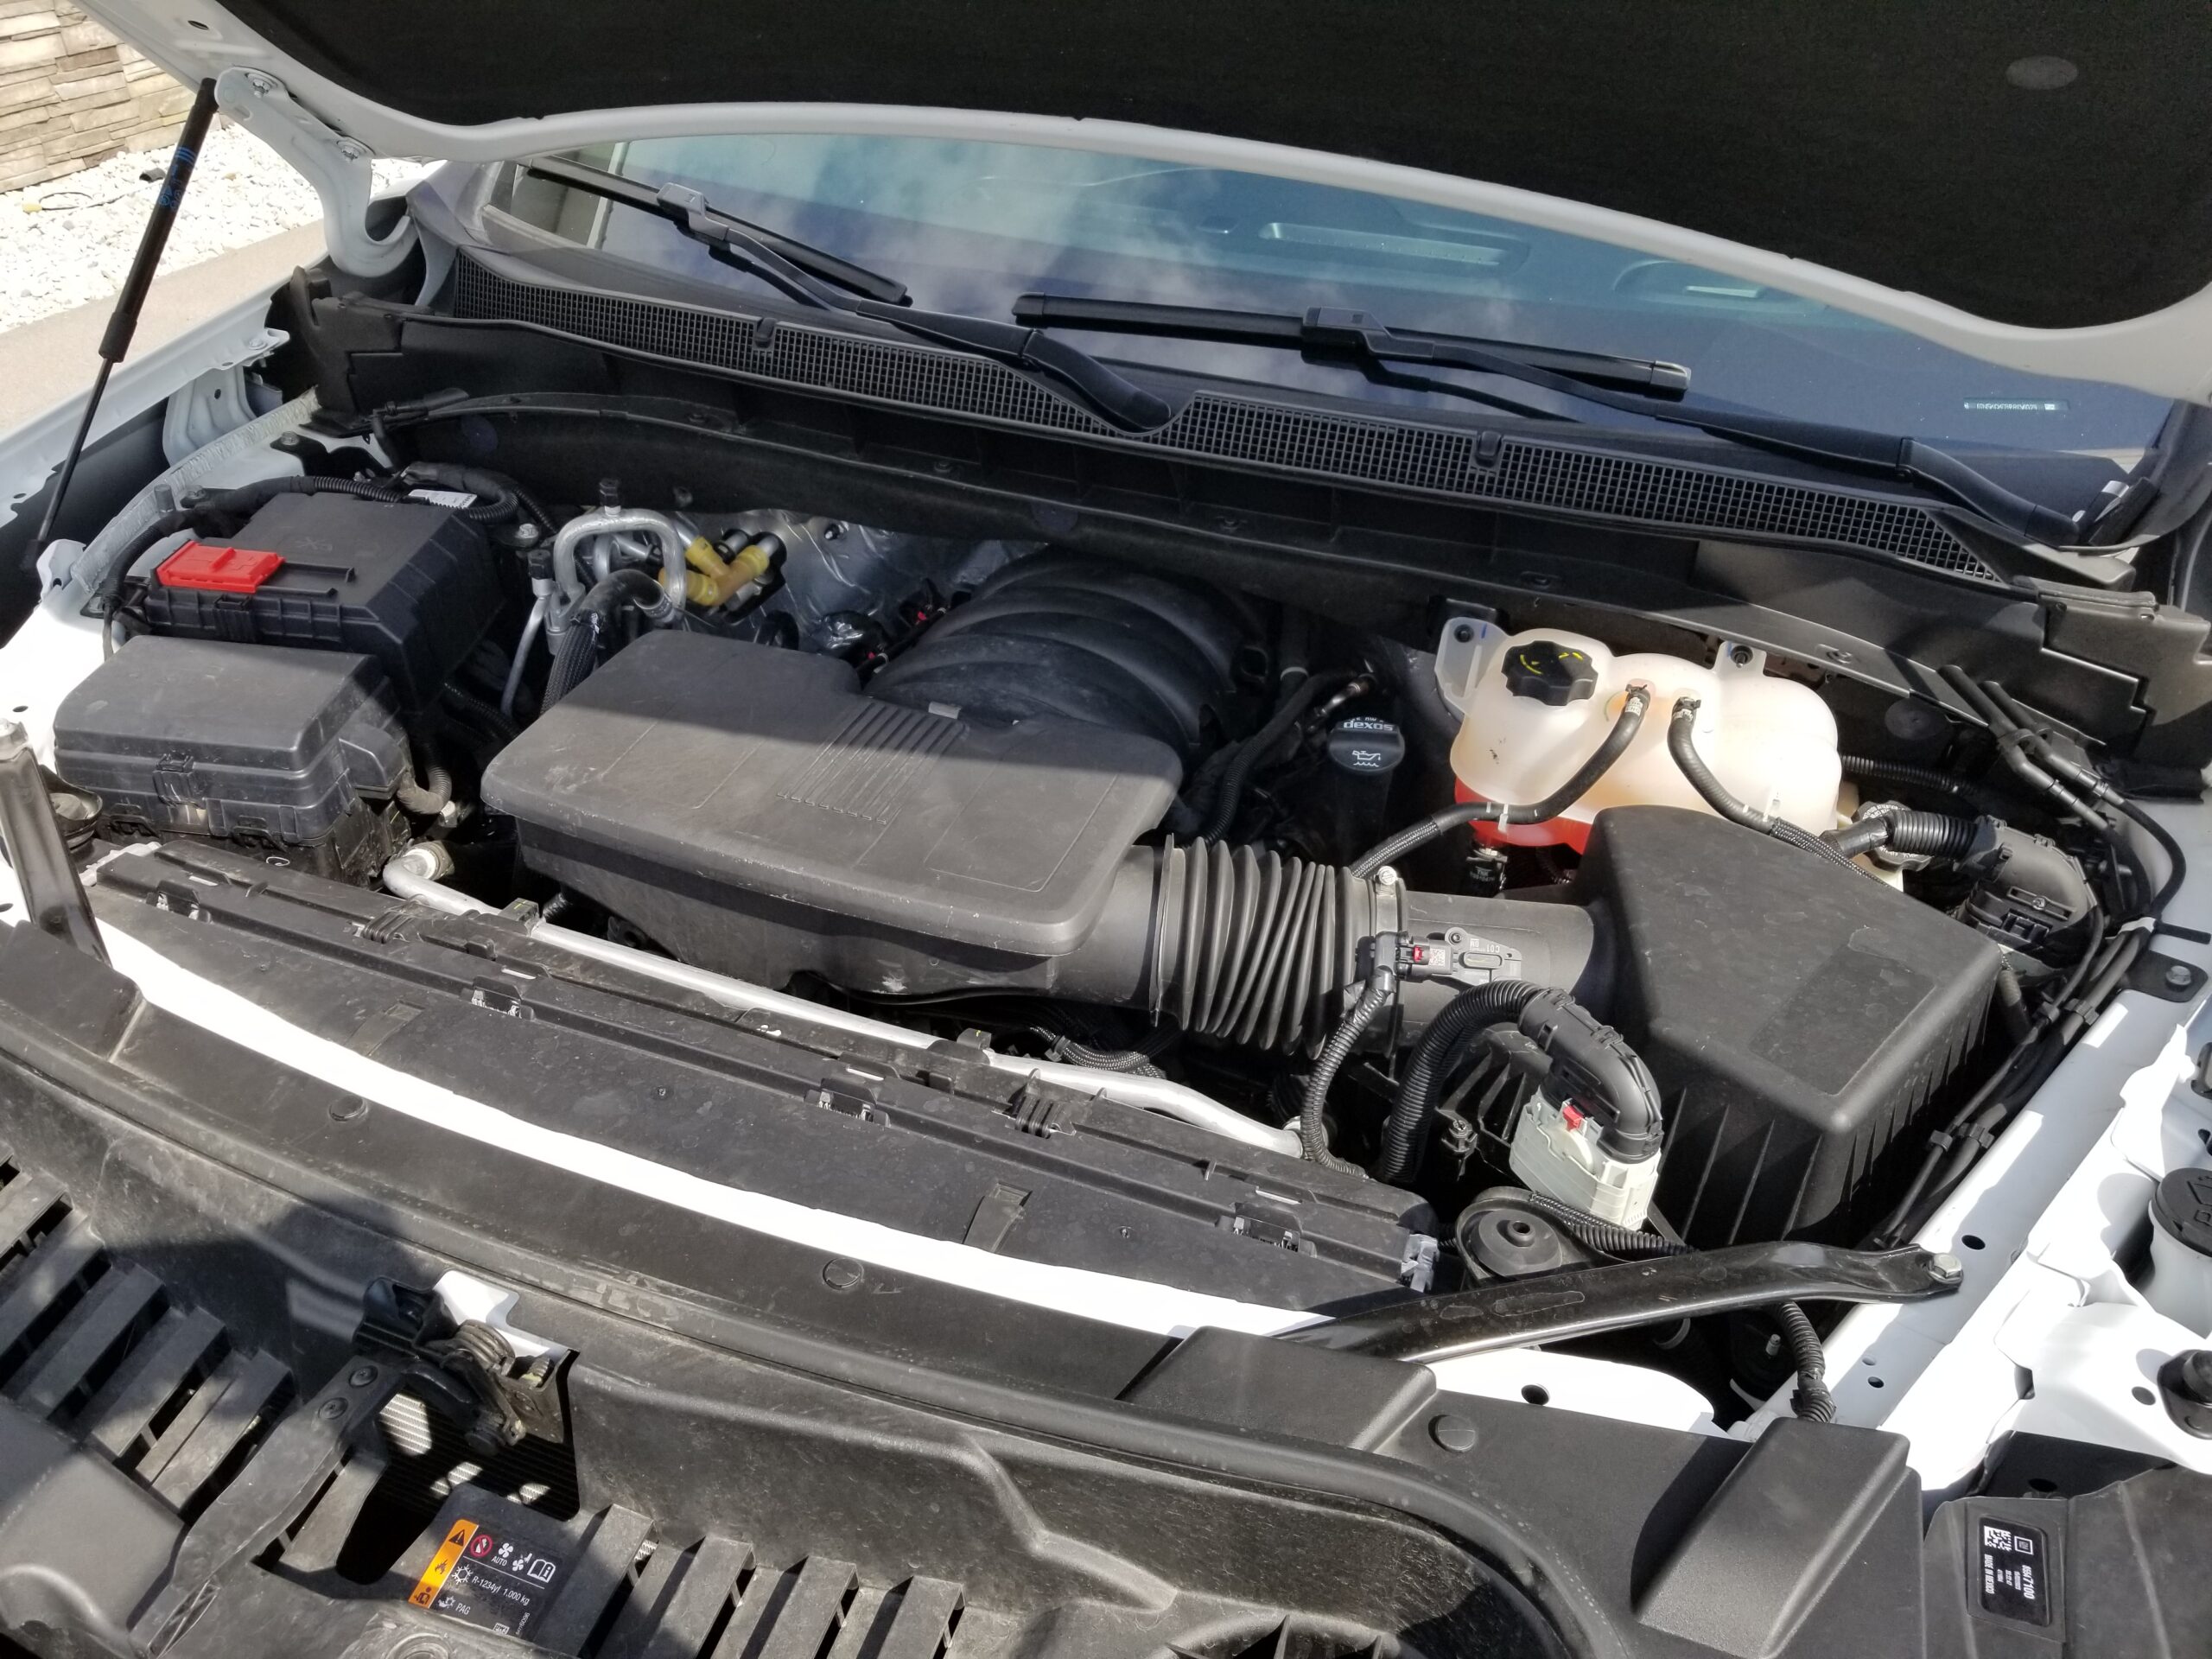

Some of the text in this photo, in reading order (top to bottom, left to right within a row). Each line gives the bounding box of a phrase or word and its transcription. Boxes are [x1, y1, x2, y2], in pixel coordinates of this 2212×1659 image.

[1343, 721, 1394, 731] dexos
[491, 1555, 507, 1567] AUTO
[503, 1588, 522, 1601] 1.000
[520, 1595, 531, 1606] kg
[455, 1603, 471, 1615] PAG
